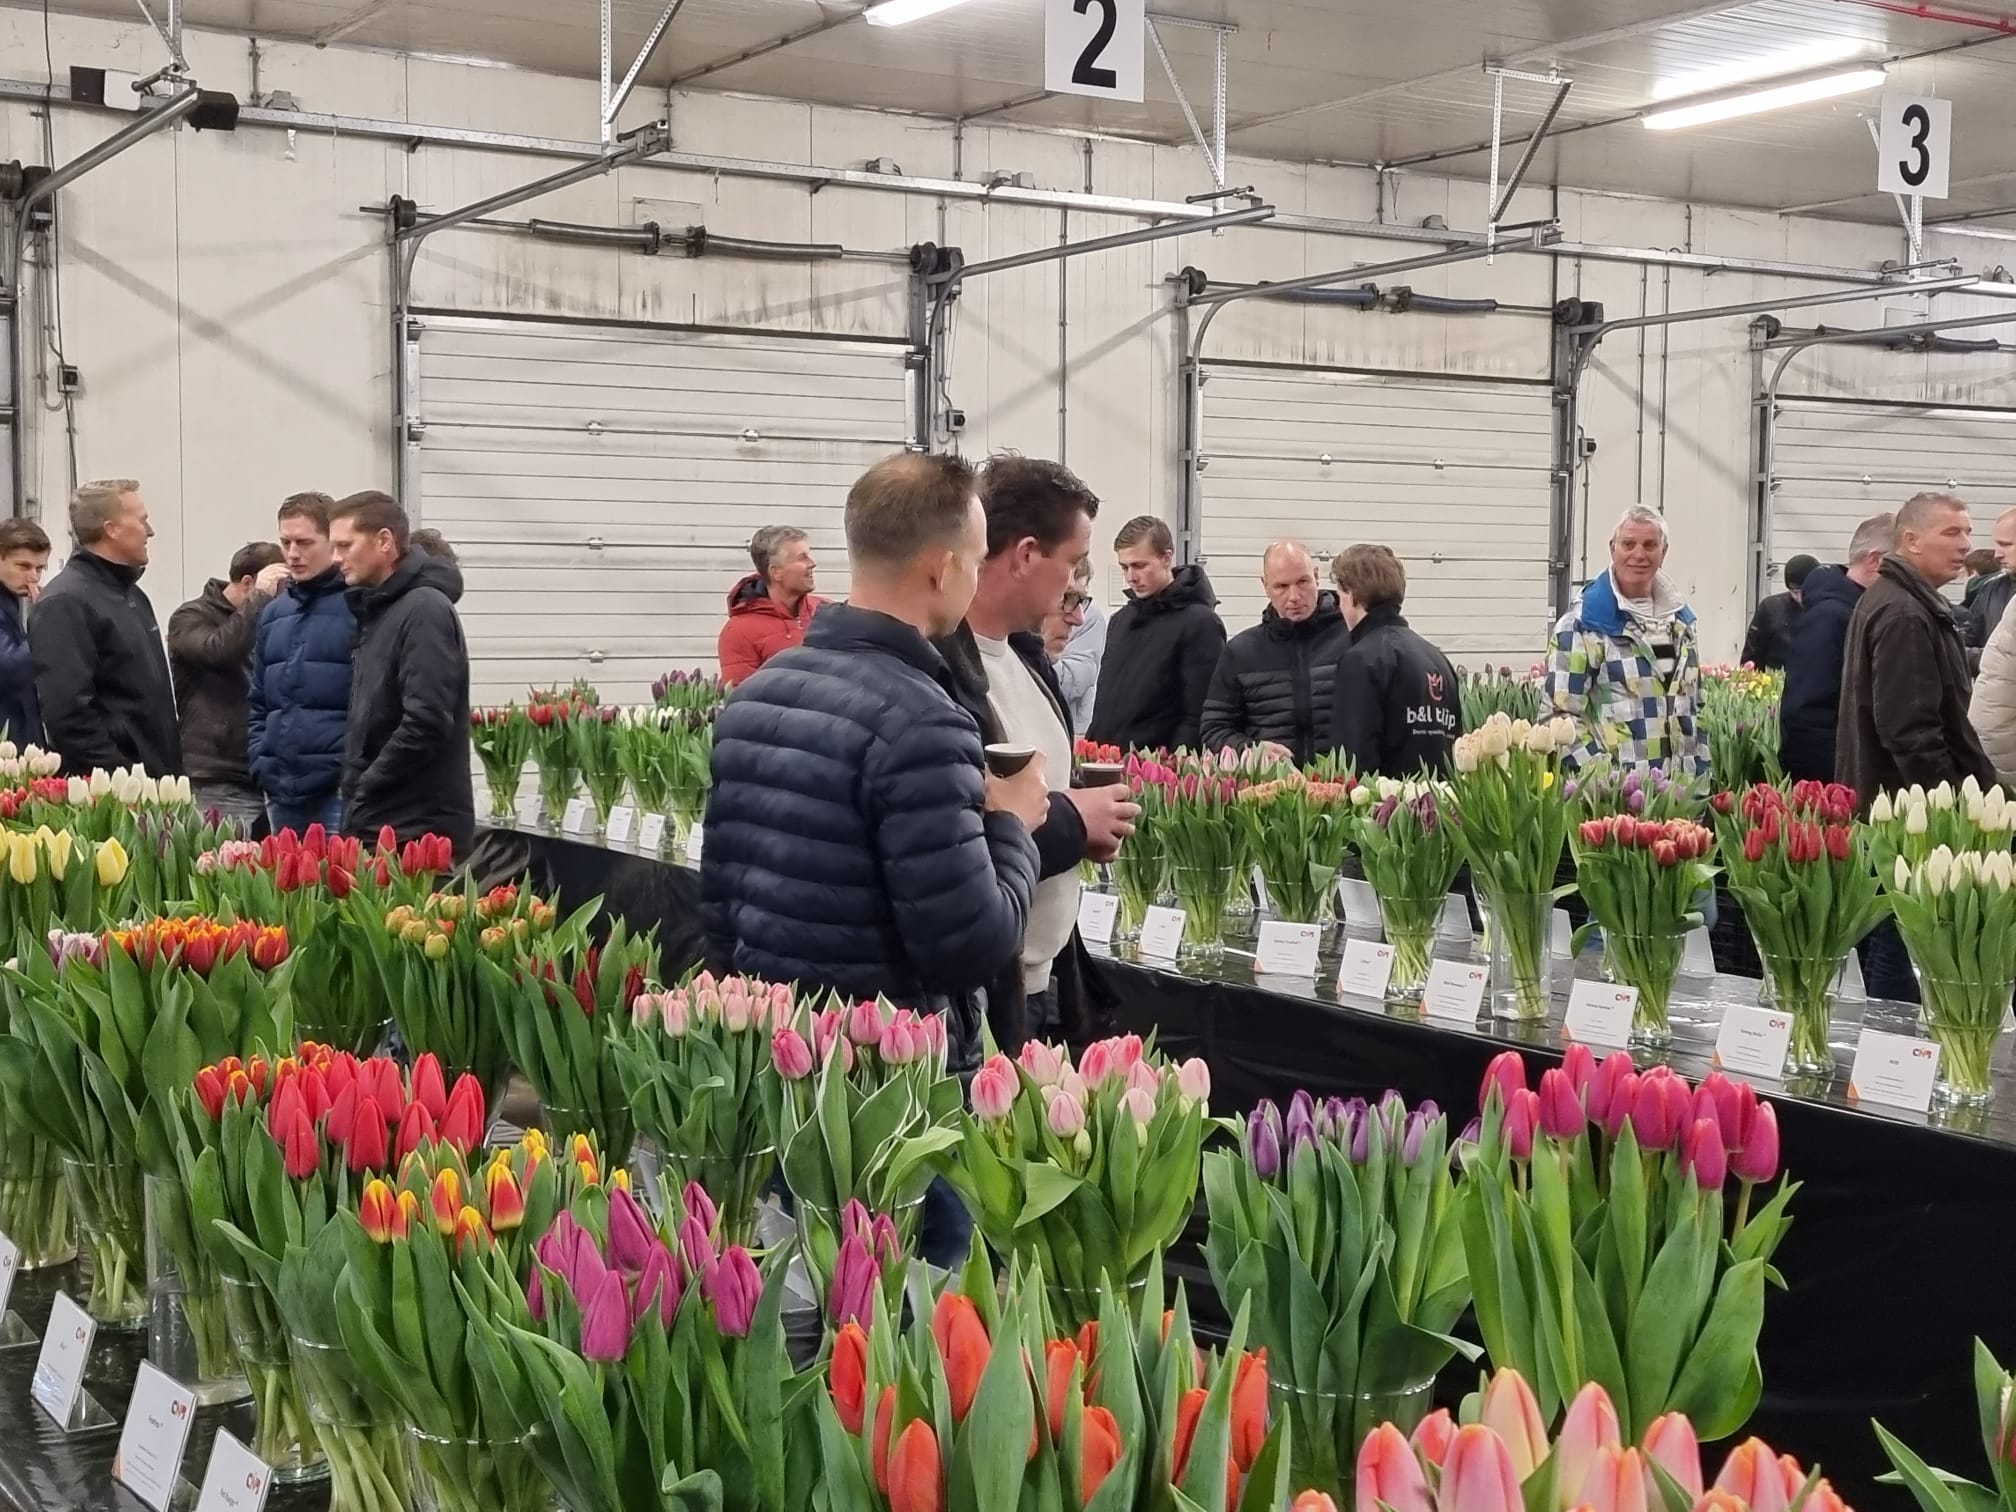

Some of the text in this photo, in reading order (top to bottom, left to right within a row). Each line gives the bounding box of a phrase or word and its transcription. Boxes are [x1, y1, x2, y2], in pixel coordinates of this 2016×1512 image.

[1072, 0, 1117, 89] 2
[1899, 104, 1930, 186] 3
[1406, 705, 1456, 731] b&l tlip
